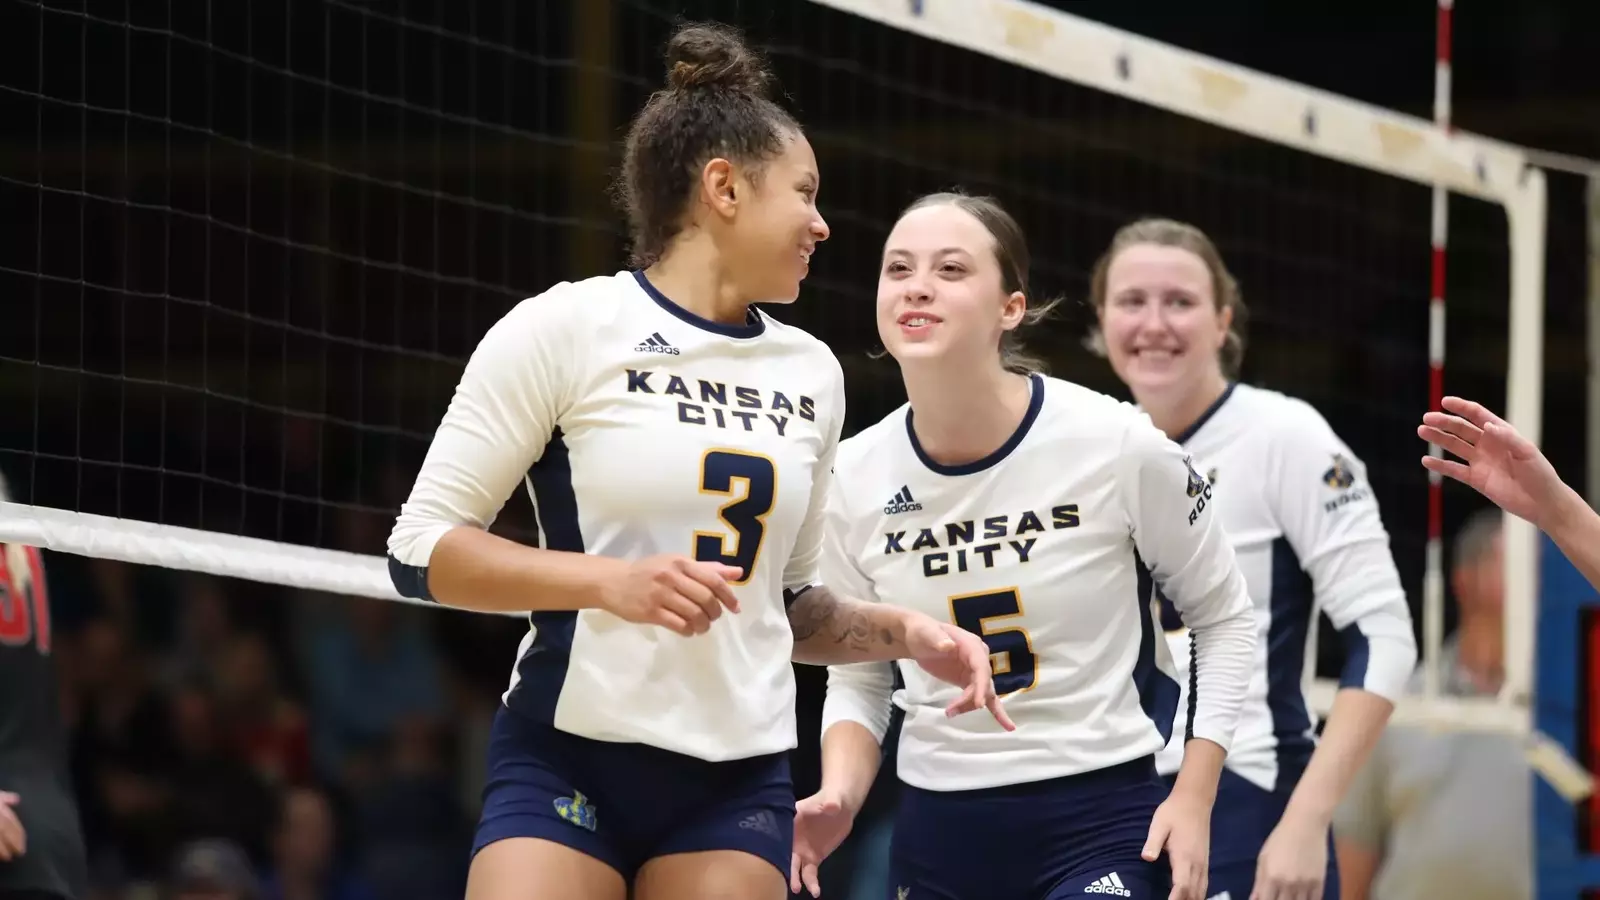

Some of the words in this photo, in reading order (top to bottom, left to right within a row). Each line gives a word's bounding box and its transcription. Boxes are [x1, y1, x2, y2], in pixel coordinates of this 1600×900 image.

[634, 345, 680, 356] adidas
[625, 369, 816, 423] KANSAS
[677, 401, 789, 437] CITY
[693, 447, 778, 586] 3
[884, 502, 923, 515] adidas
[884, 504, 1081, 555] KANSAS
[922, 537, 1038, 578] CITY
[947, 585, 1039, 698] 5
[1084, 884, 1131, 898] adidas
